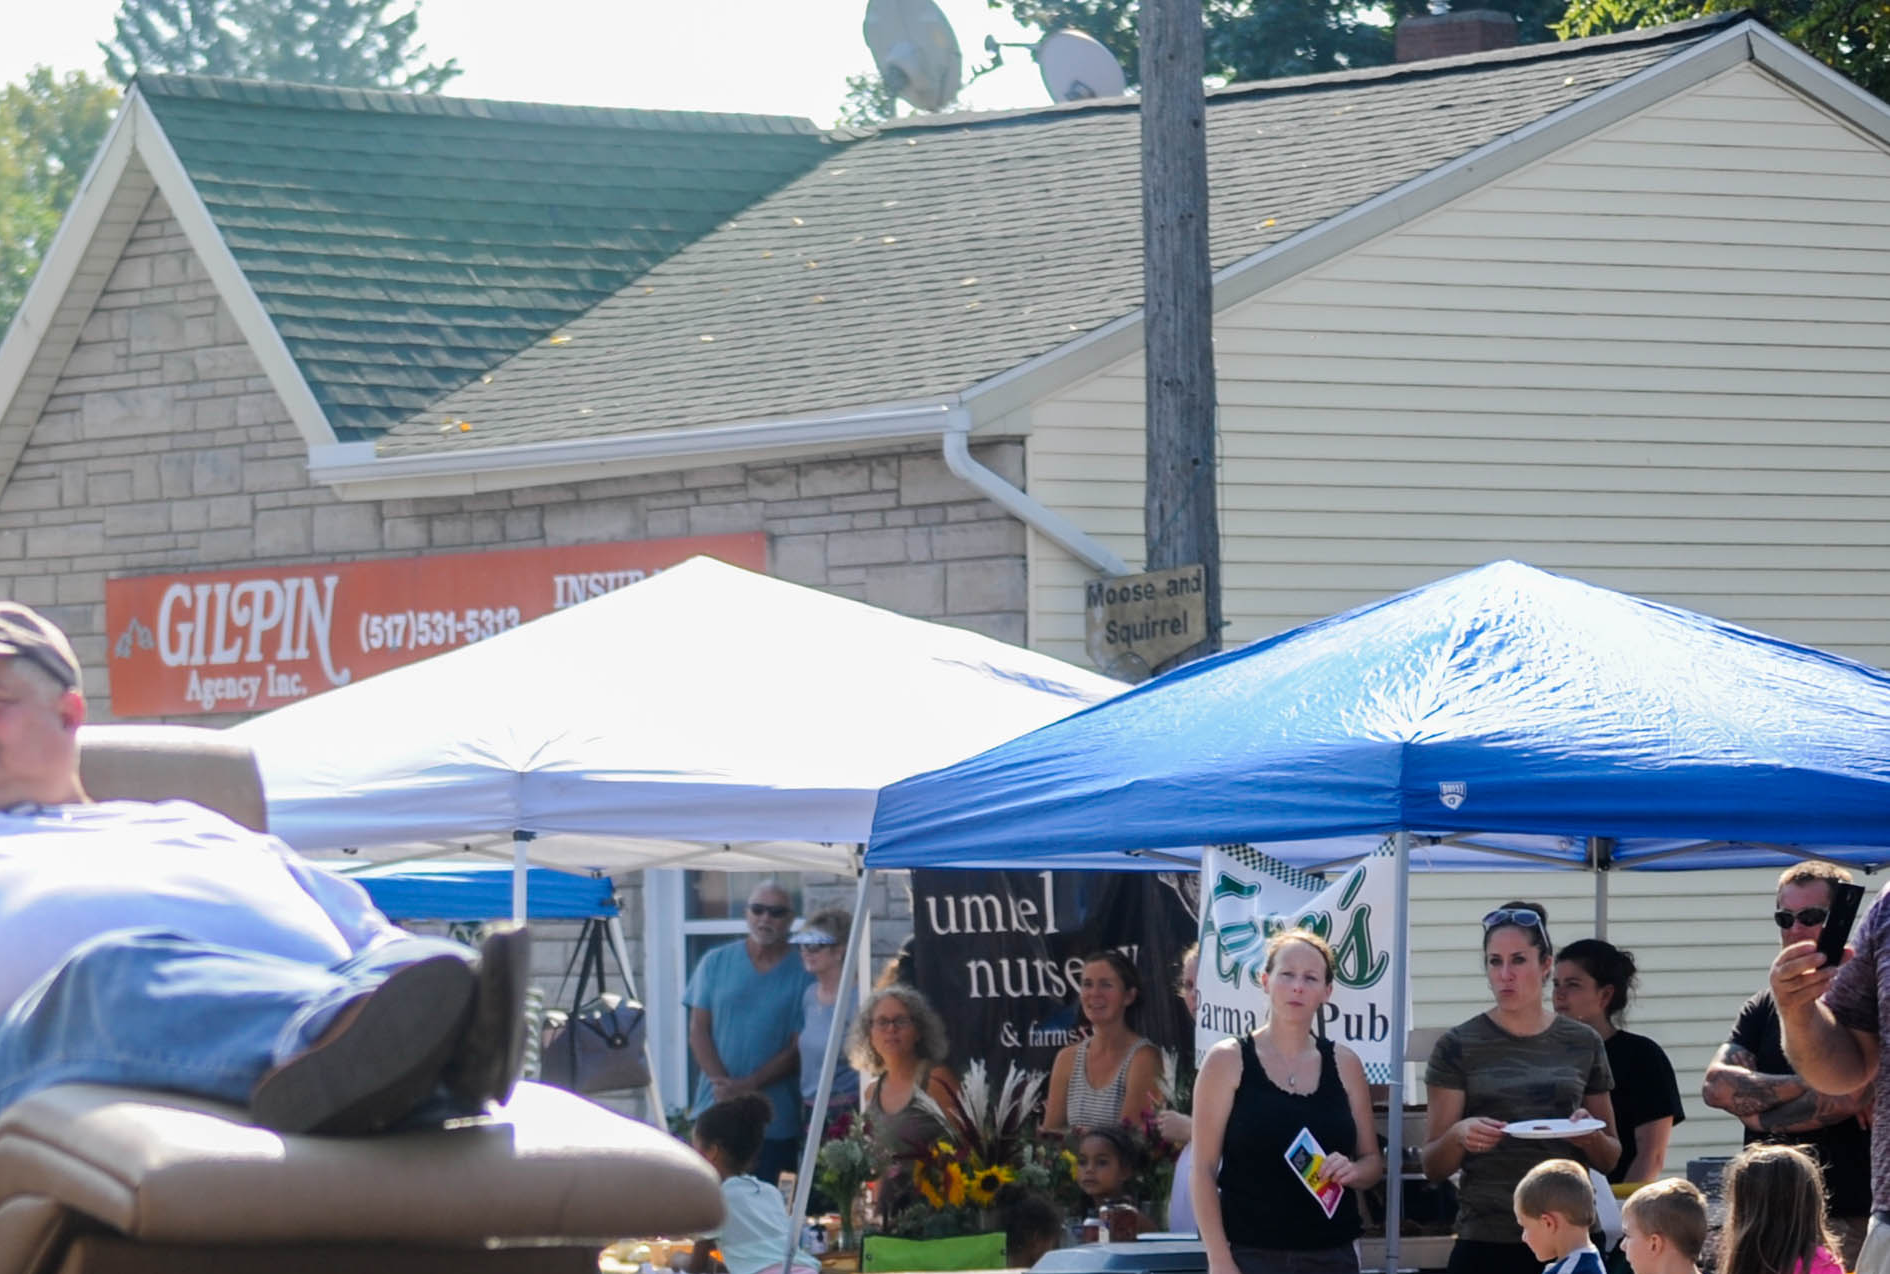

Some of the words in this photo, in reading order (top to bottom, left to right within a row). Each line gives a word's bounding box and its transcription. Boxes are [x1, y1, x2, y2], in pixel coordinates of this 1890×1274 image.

[1086, 582, 1156, 608] Moose
[1166, 569, 1203, 597] and
[158, 575, 351, 686] GILPIN
[1105, 610, 1189, 649] Squirrel
[185, 669, 262, 710] Agency
[266, 664, 308, 697] Inc.
[1000, 1021, 1023, 1048] &
[1316, 1001, 1389, 1042] Pub
